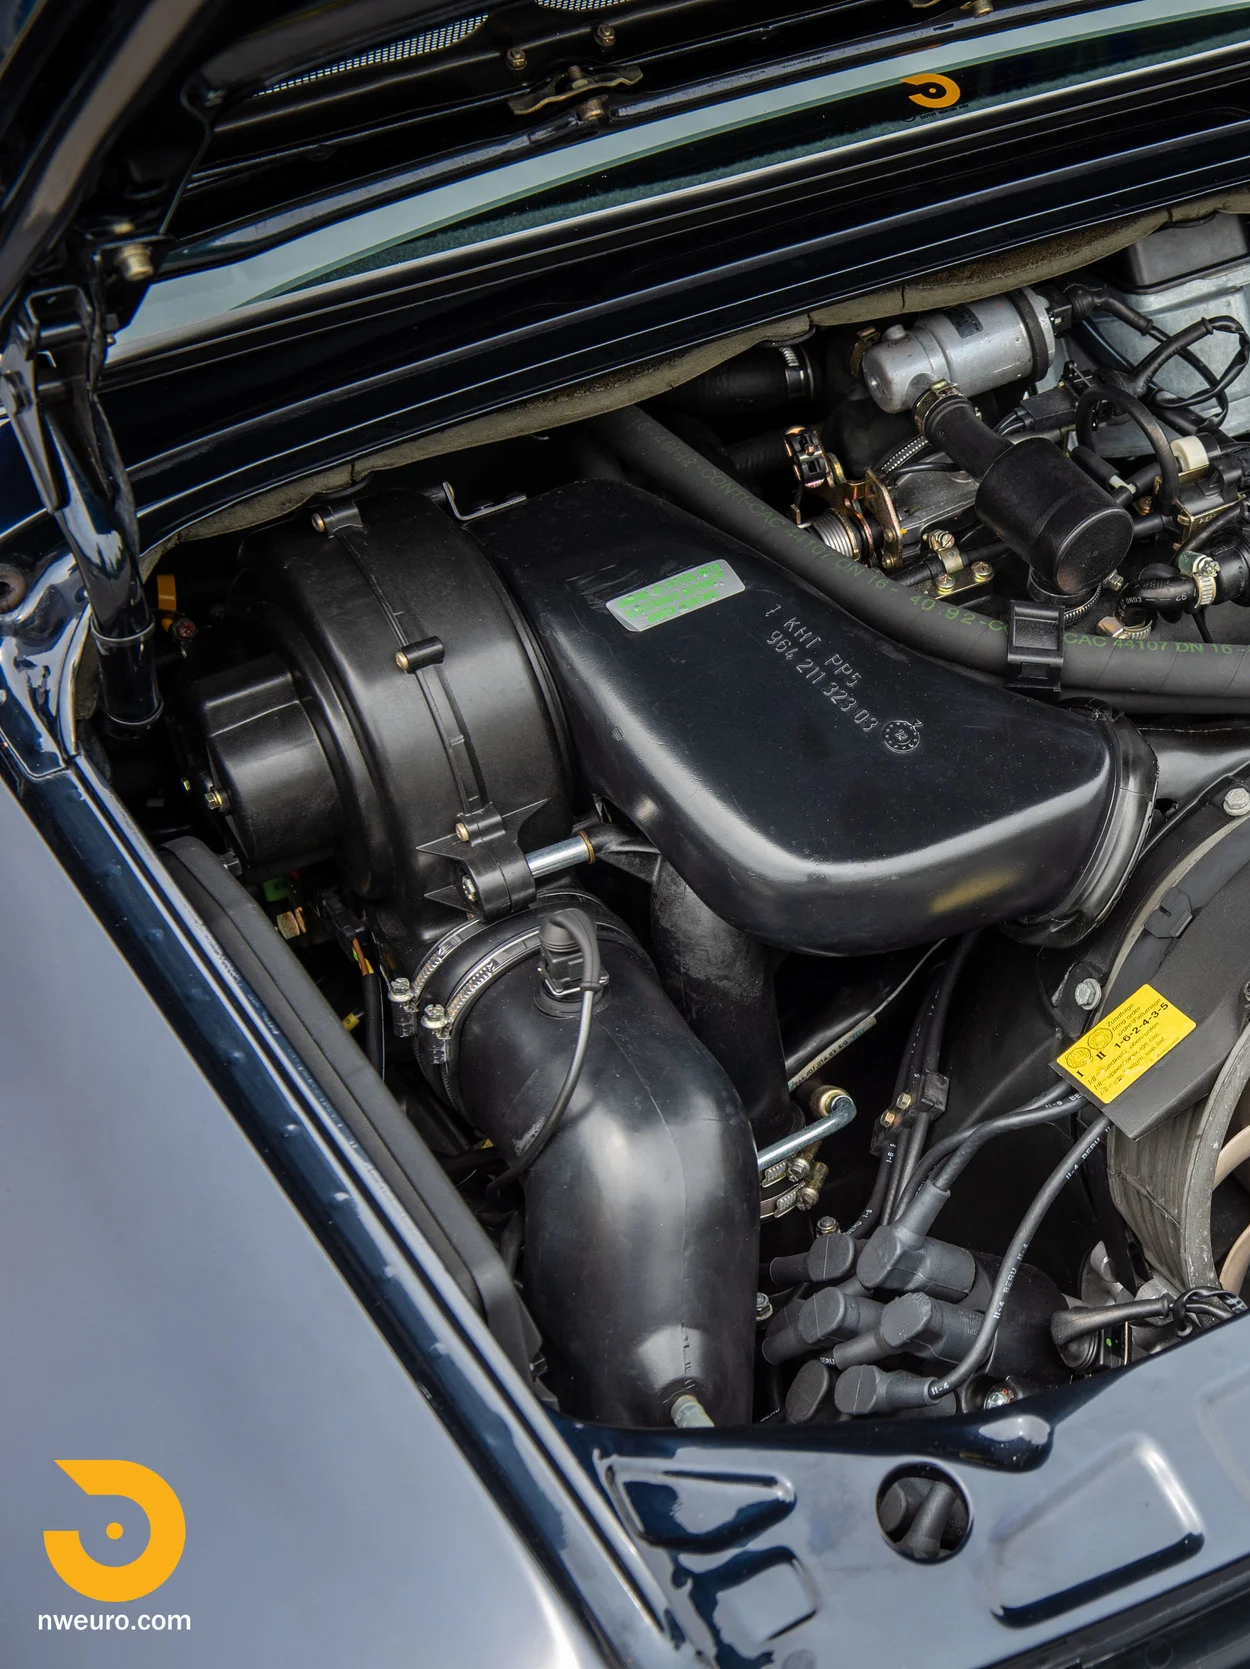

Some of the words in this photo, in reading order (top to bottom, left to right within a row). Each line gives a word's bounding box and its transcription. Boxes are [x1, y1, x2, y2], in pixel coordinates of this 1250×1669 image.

[867, 571, 891, 590] 16
[1112, 637, 1168, 652] 44107
[1175, 641, 1204, 654] DN
[1211, 643, 1233, 655] 16
[766, 630, 799, 660] 964
[796, 658, 826, 684] 211
[823, 682, 857, 712] 323
[854, 709, 879, 732] 03
[1096, 1051, 1107, 1061] II
[1114, 1002, 1169, 1049] 1-6-2-4-3-5
[1002, 1267, 1018, 1294] BERU
